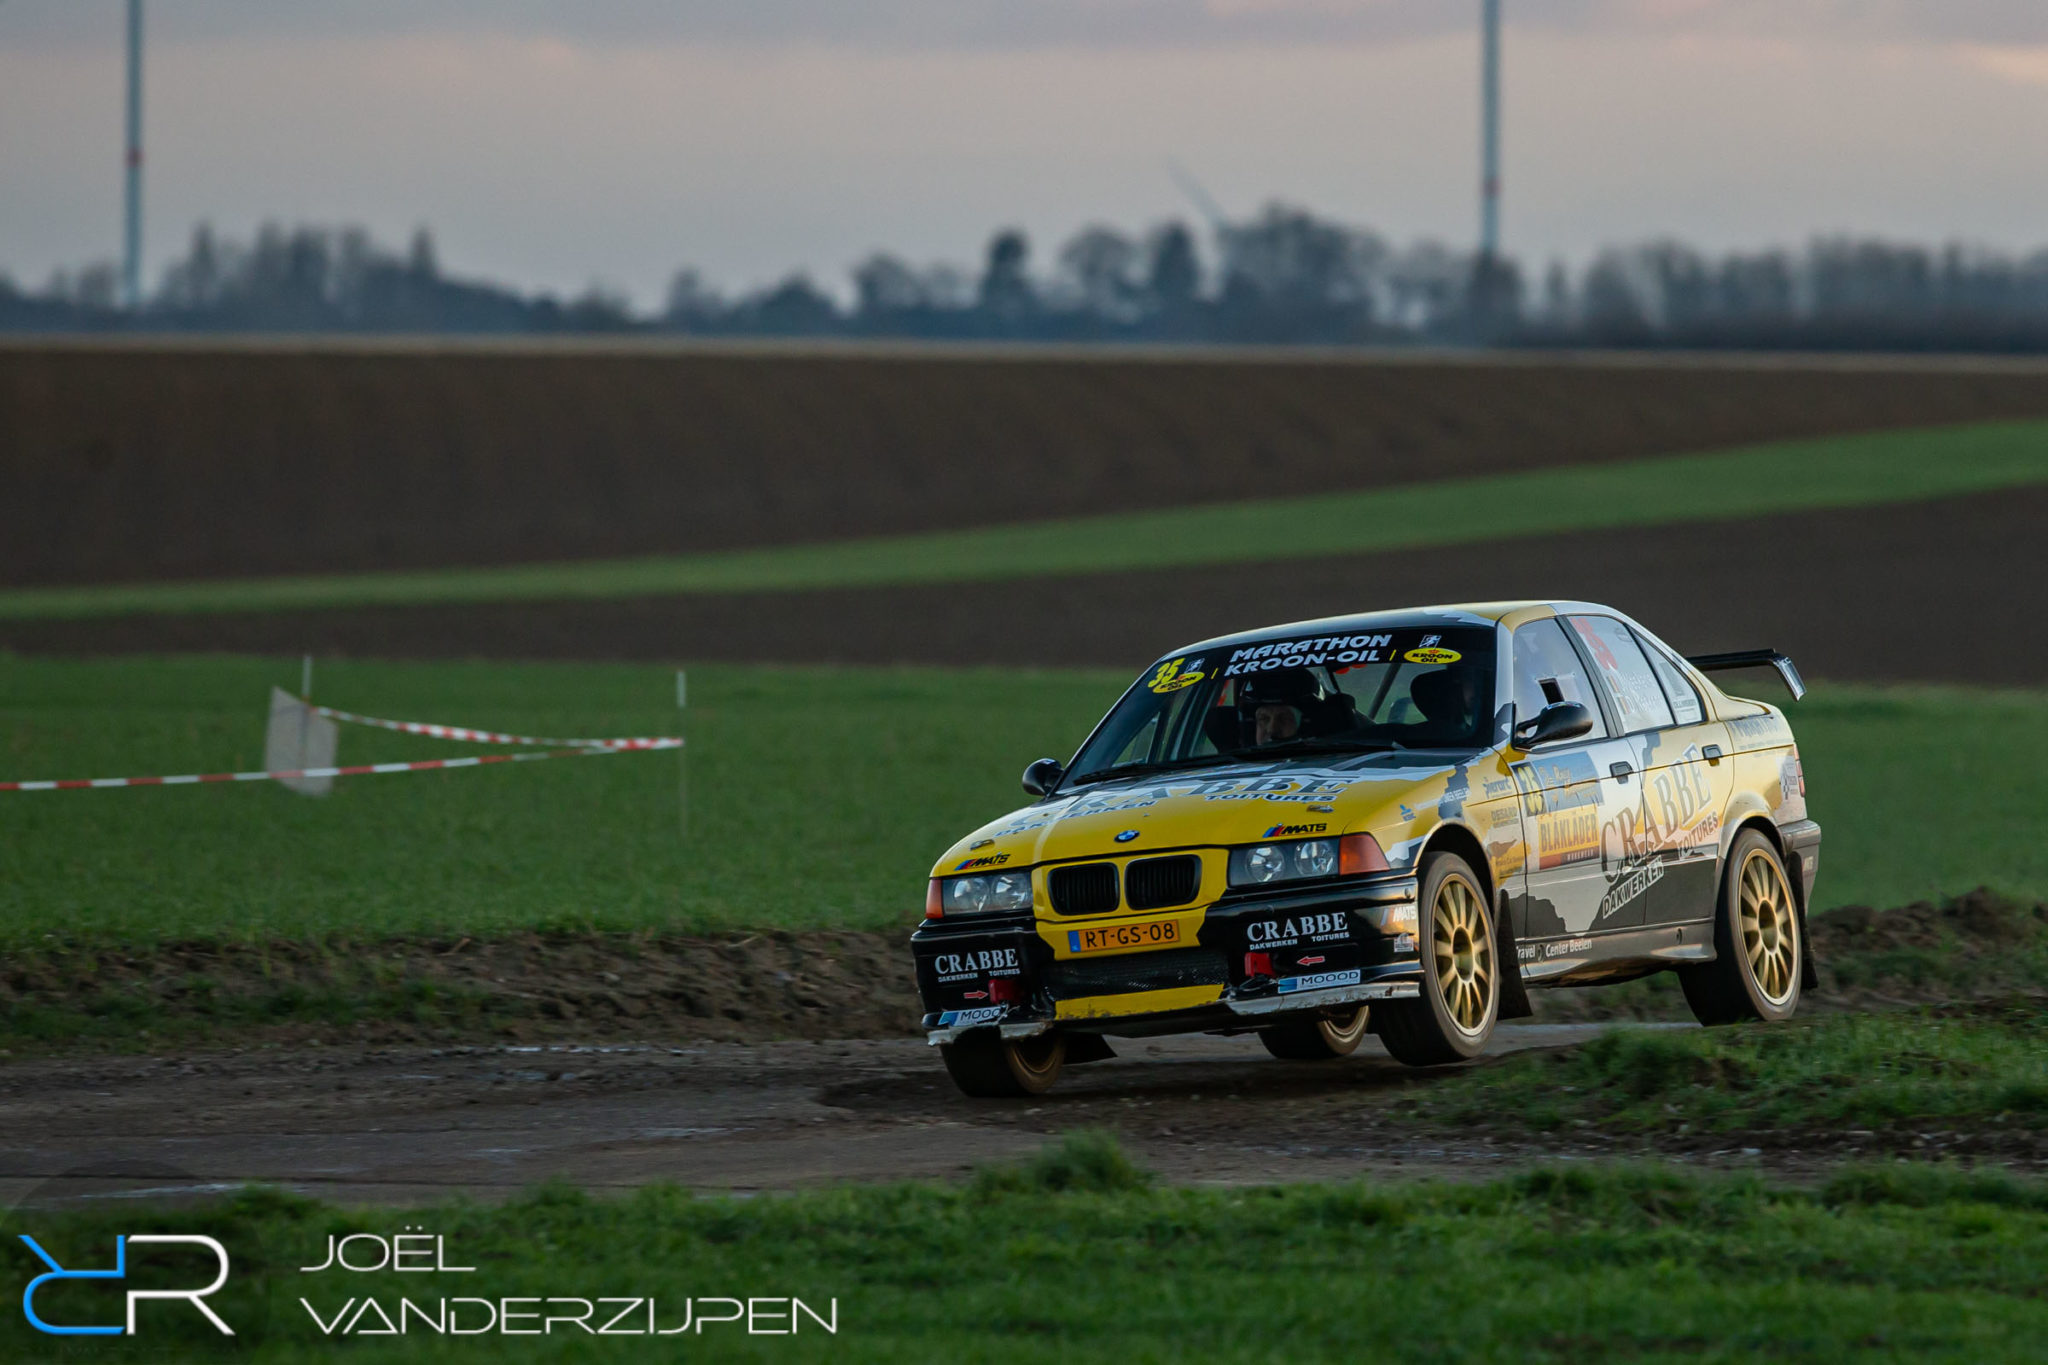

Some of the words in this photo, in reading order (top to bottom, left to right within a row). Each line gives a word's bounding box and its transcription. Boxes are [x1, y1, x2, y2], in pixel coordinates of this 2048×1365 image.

[1230, 634, 1392, 662] MARATHON
[1412, 652, 1453, 660] KROON
[1148, 658, 1185, 688] 35
[1224, 650, 1380, 676] KROON-OIL
[1160, 676, 1198, 689] KROON
[1206, 792, 1338, 803] TOITURES
[1601, 743, 1711, 885] CRABBE
[1678, 810, 1719, 861] TOITURES
[1603, 855, 1664, 919] DAKWERKEN
[1085, 923, 1175, 948] RT-GS-08
[1247, 912, 1348, 941] CRABBE
[1250, 939, 1298, 950] DAKWERKEN
[1312, 931, 1350, 942] TOITURES
[1545, 943, 1568, 957] Center
[935, 948, 1018, 974] CRABBE
[938, 972, 978, 982] DAKWERKEN
[988, 968, 1020, 977] TOITURES
[1302, 971, 1359, 985] MOOOD
[961, 1007, 1002, 1021] MOOO
